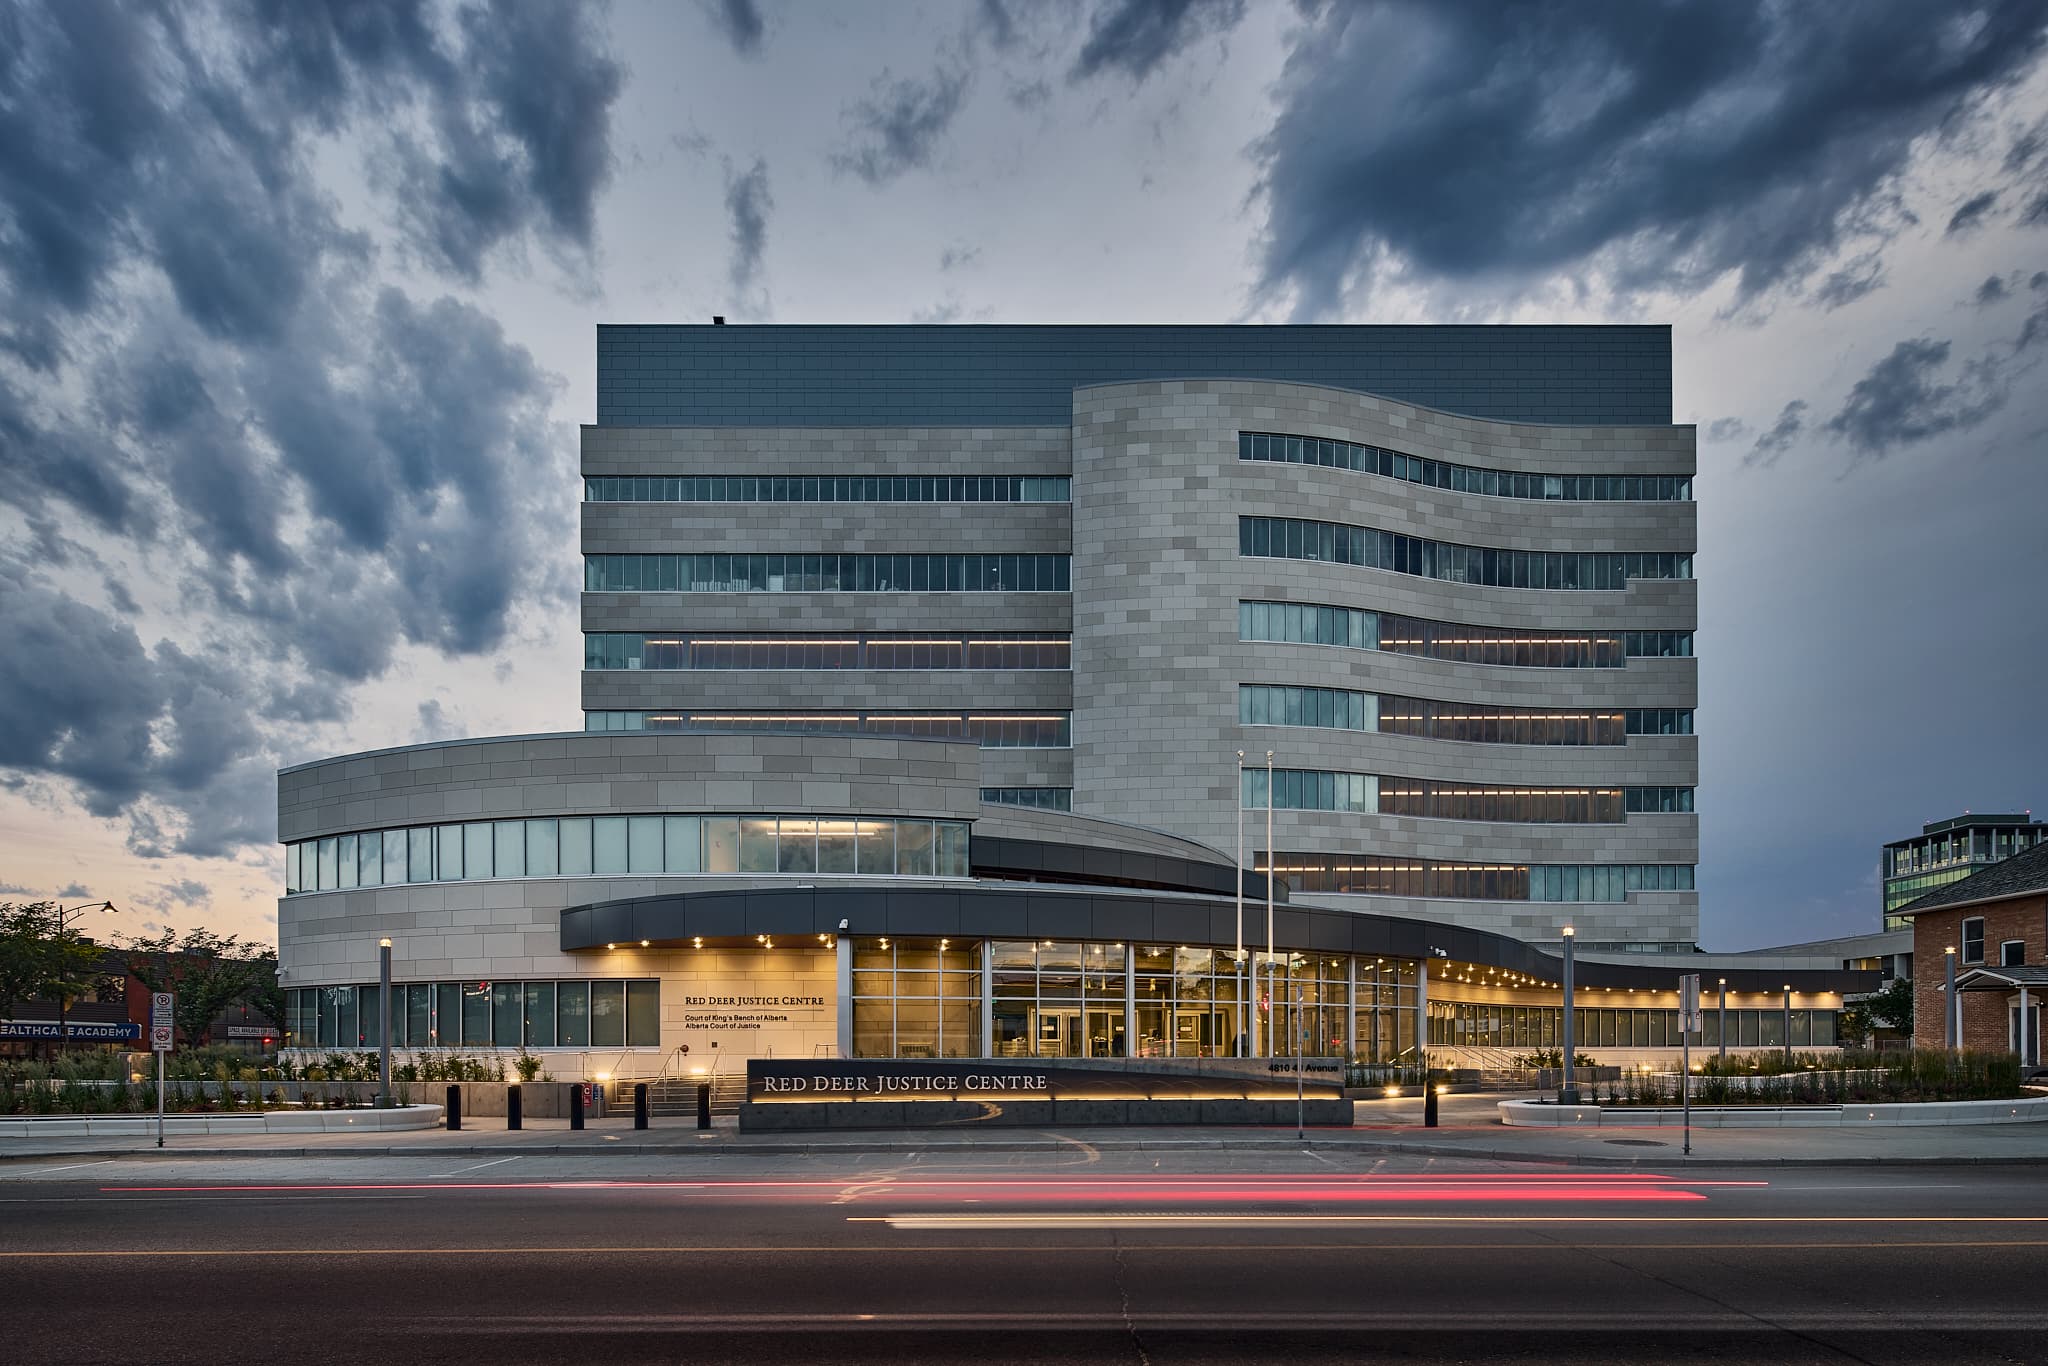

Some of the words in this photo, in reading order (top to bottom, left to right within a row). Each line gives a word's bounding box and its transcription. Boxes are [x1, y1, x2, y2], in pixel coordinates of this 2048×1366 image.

[685, 997, 706, 1005] RED
[709, 997, 735, 1005] DEER
[737, 997, 779, 1006] JUSTICE
[782, 997, 824, 1005] CENTRE
[0, 1025, 75, 1036] EALTHCAE
[76, 1027, 132, 1037] ACADEMY
[1268, 1064, 1290, 1073] 4810
[1305, 1064, 1339, 1073] Avenue
[763, 1076, 807, 1092] RED
[813, 1076, 870, 1091] DEER
[874, 1075, 959, 1095] JUSTICE
[964, 1074, 1047, 1090] CENTRE
